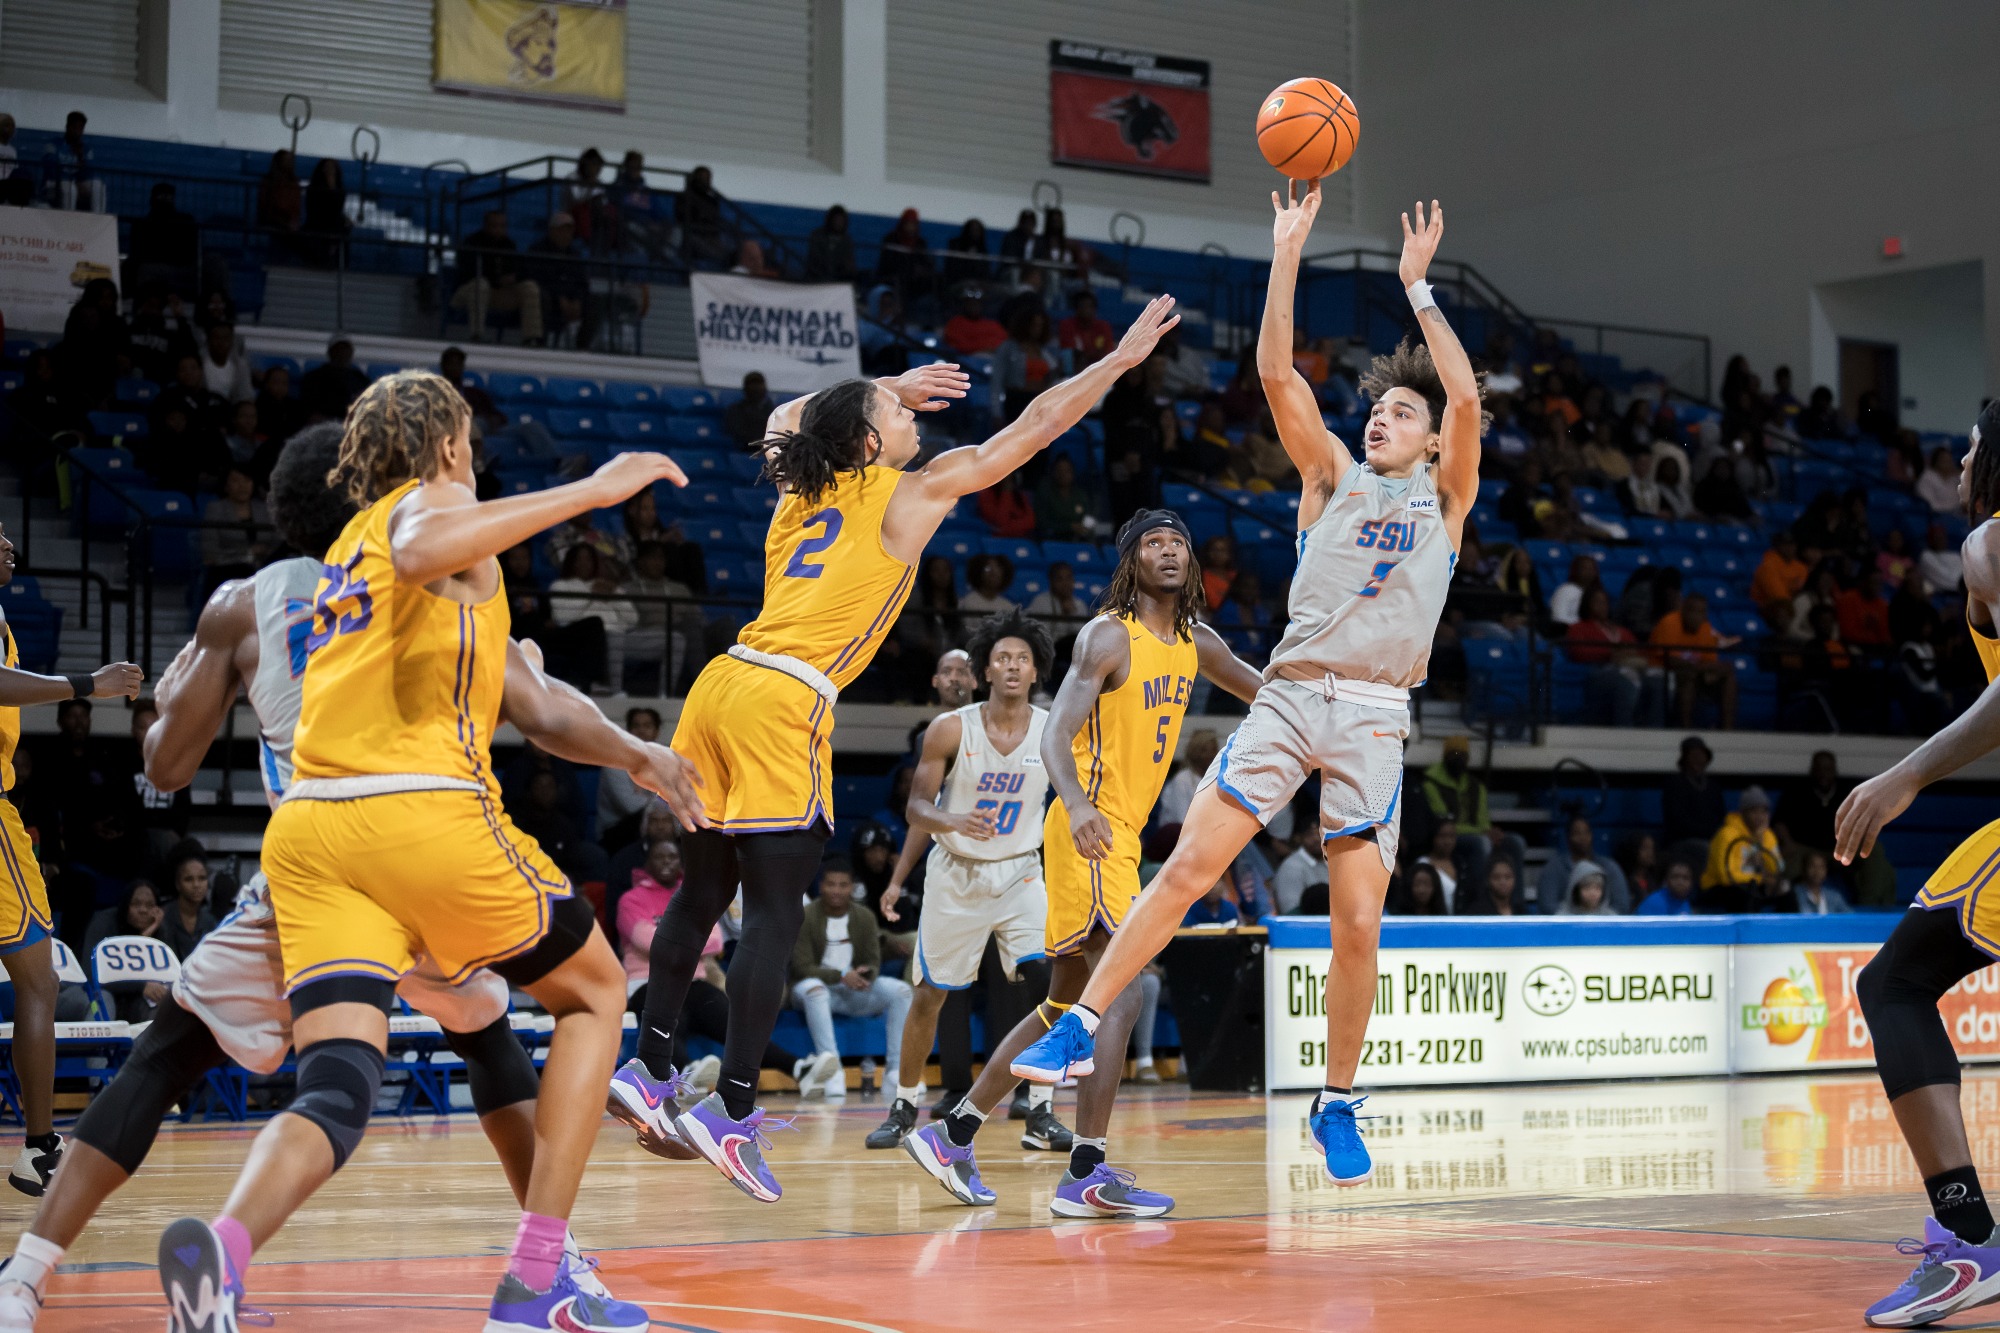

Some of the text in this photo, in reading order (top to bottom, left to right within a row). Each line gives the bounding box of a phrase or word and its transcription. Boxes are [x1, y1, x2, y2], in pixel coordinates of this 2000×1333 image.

[707, 302, 843, 329] SAVANNAH
[700, 320, 854, 349] HILTON HEAD
[1409, 499, 1435, 509] SIAC
[783, 507, 845, 578] 2
[1355, 519, 1417, 553] SSU
[1143, 674, 1193, 710] MILES
[1153, 715, 1171, 764] 5
[976, 772, 1026, 794] SSU
[101, 944, 170, 971] SSU
[1405, 963, 1507, 1022] Parkway
[1584, 974, 1713, 1002] SUBARU
[1746, 1006, 1826, 1027] LOTTERY
[1956, 1004, 2000, 1044] da
[68, 1027, 112, 1037] TIGERS
[1522, 1032, 1708, 1062] www.cpsubaru.com
